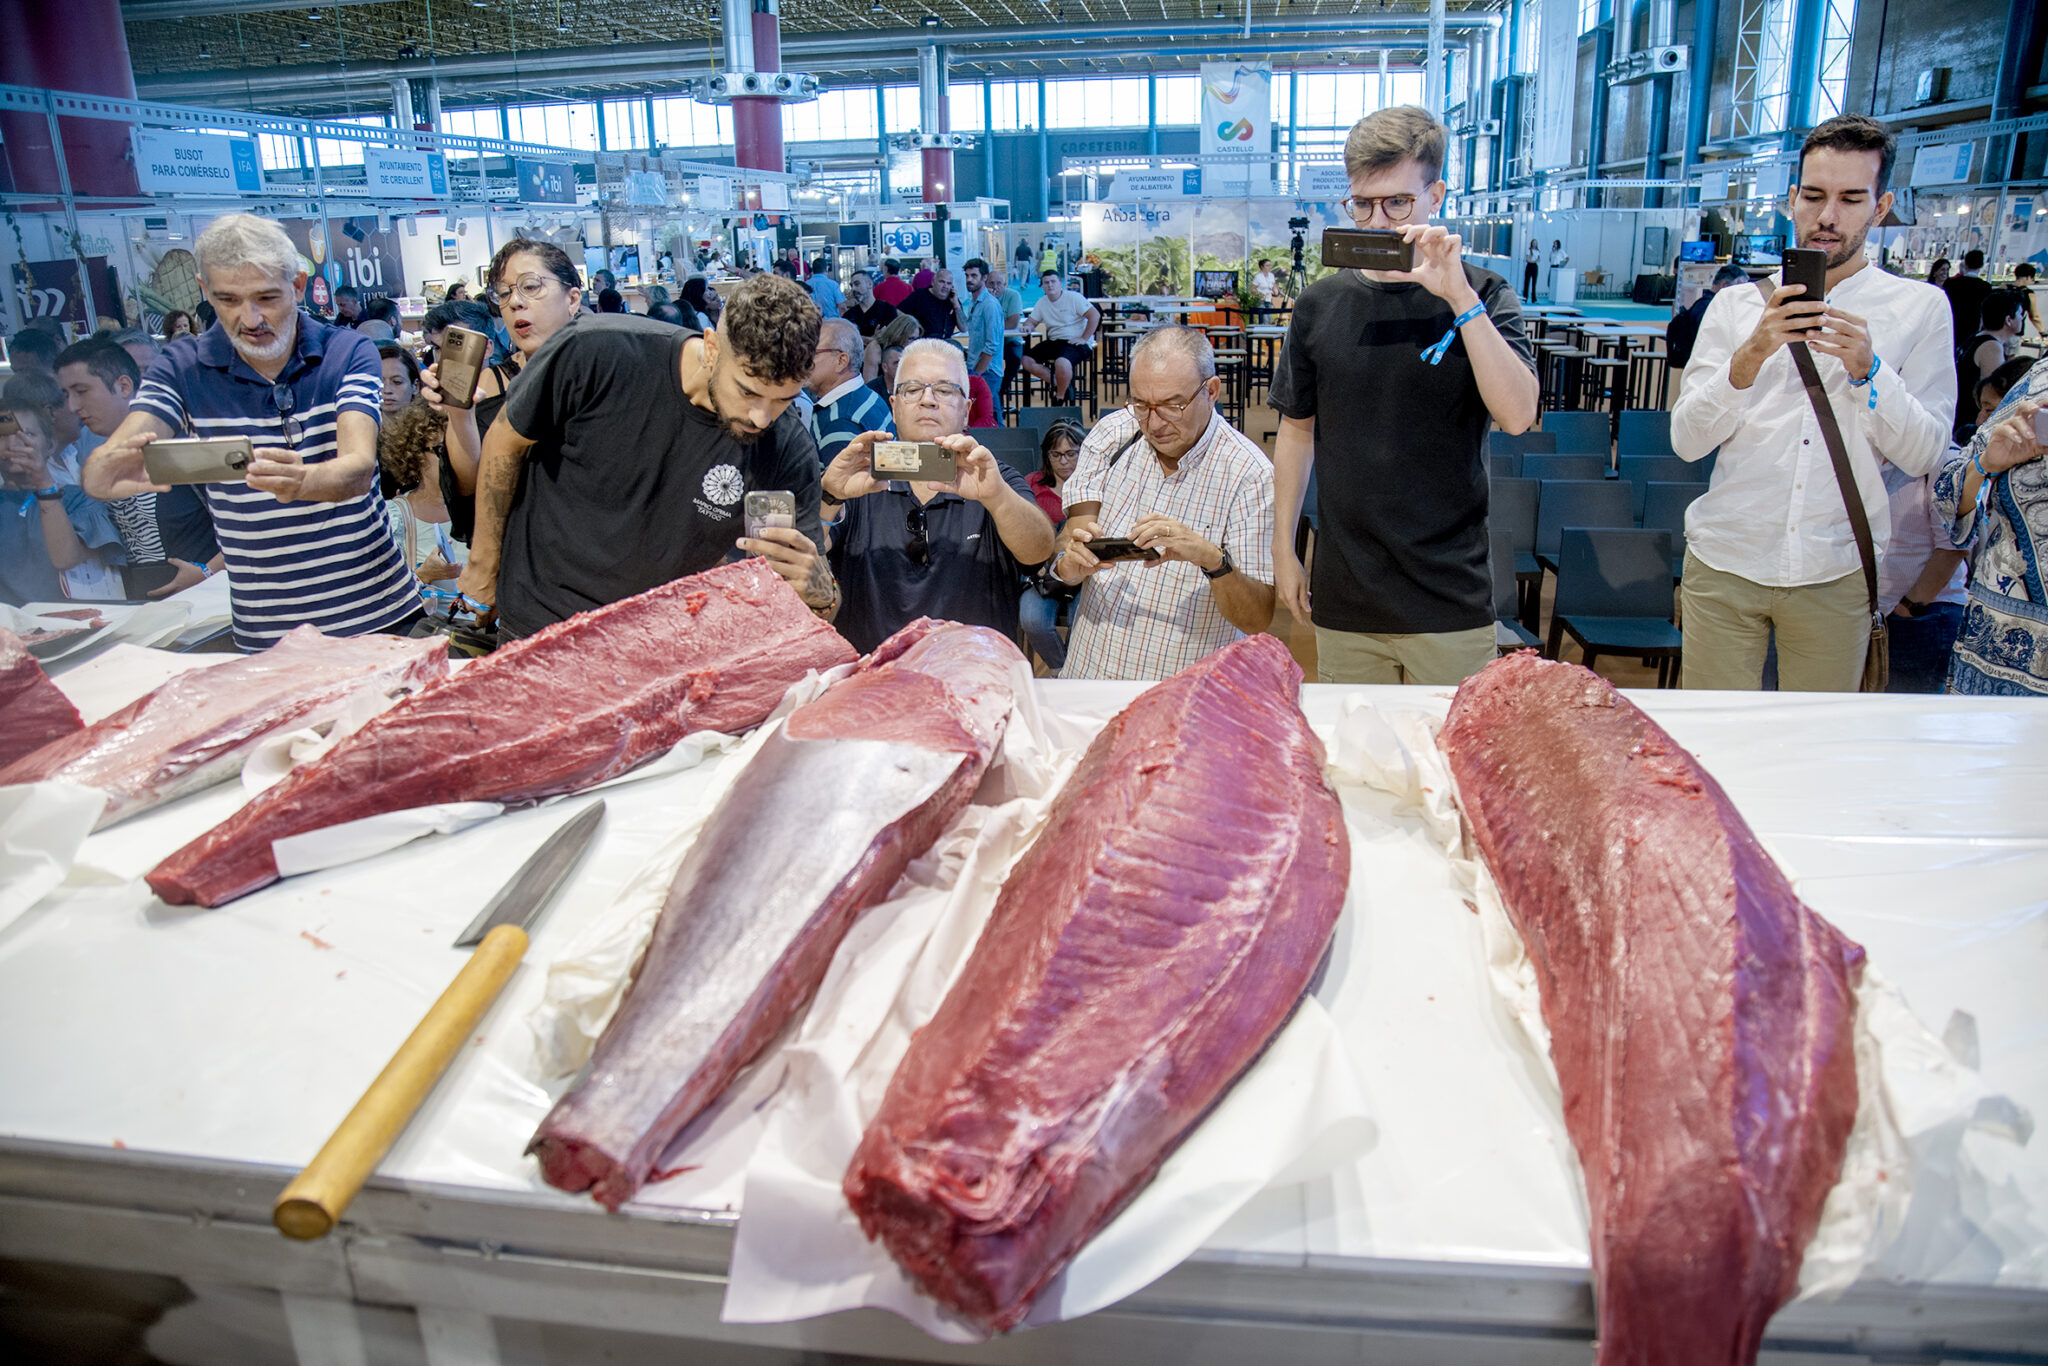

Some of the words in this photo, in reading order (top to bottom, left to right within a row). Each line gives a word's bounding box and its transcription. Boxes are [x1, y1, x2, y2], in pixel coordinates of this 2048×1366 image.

[1060, 141, 1137, 153] CAFETERIA
[174, 148, 203, 160] BUSOT
[152, 164, 177, 176] PARA
[179, 164, 230, 178] COMÉRSELO
[238, 160, 253, 172] IFA
[379, 162, 422, 171] AYUNTAMIENTO
[380, 175, 389, 183] DE
[390, 175, 424, 184] CREVILLENT
[550, 175, 562, 192] ibi
[347, 246, 383, 288] ibi
